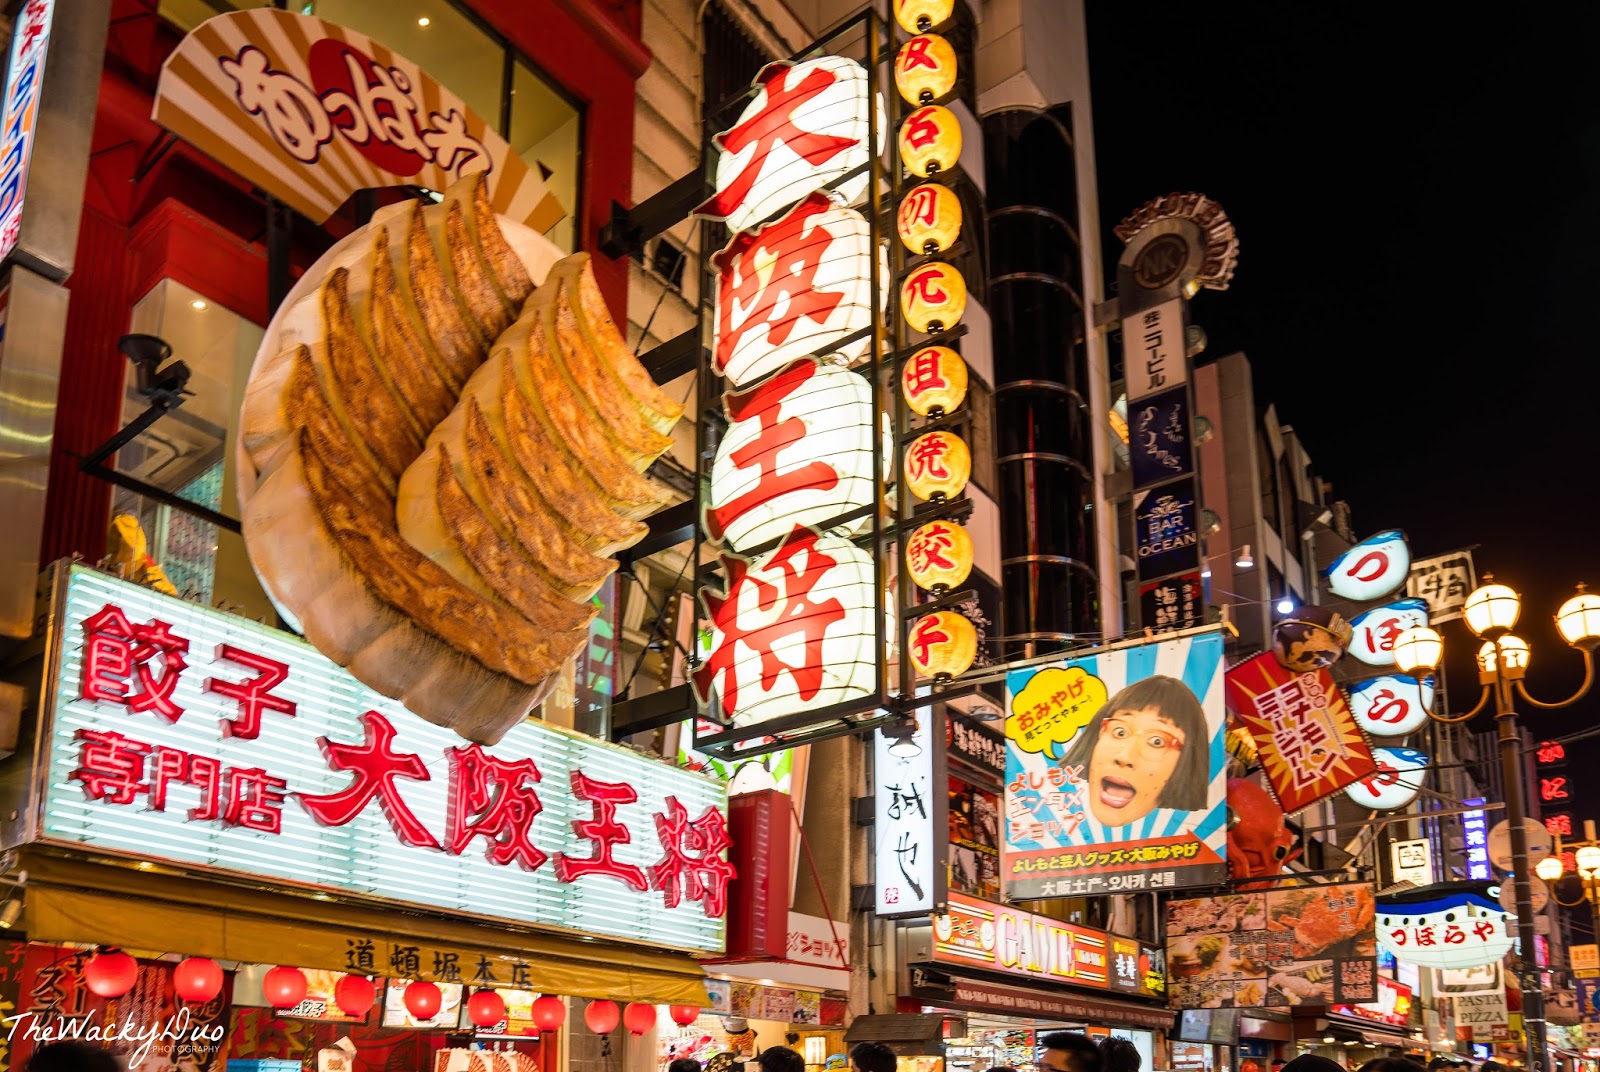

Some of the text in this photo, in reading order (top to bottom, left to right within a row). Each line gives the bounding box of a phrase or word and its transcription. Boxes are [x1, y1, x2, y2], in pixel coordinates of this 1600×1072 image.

[897, 0, 955, 667] 阪名物元祖焼餃子
[690, 62, 861, 719] 大阪王将
[1138, 532, 1197, 557] OCEAN
[1148, 515, 1184, 535] BAR
[80, 603, 297, 740] 餃子
[1017, 676, 1084, 731] おみやげ
[68, 729, 287, 835] 専門店
[1009, 765, 1084, 793] よしもと
[286, 710, 738, 919] 大阪王将
[1010, 811, 1086, 842] ショップ
[345, 938, 535, 991] 道頓堀本店
[997, 912, 1076, 979] GAME
[1457, 994, 1504, 1007] PASTA
[1459, 1011, 1505, 1024] PIZZA
